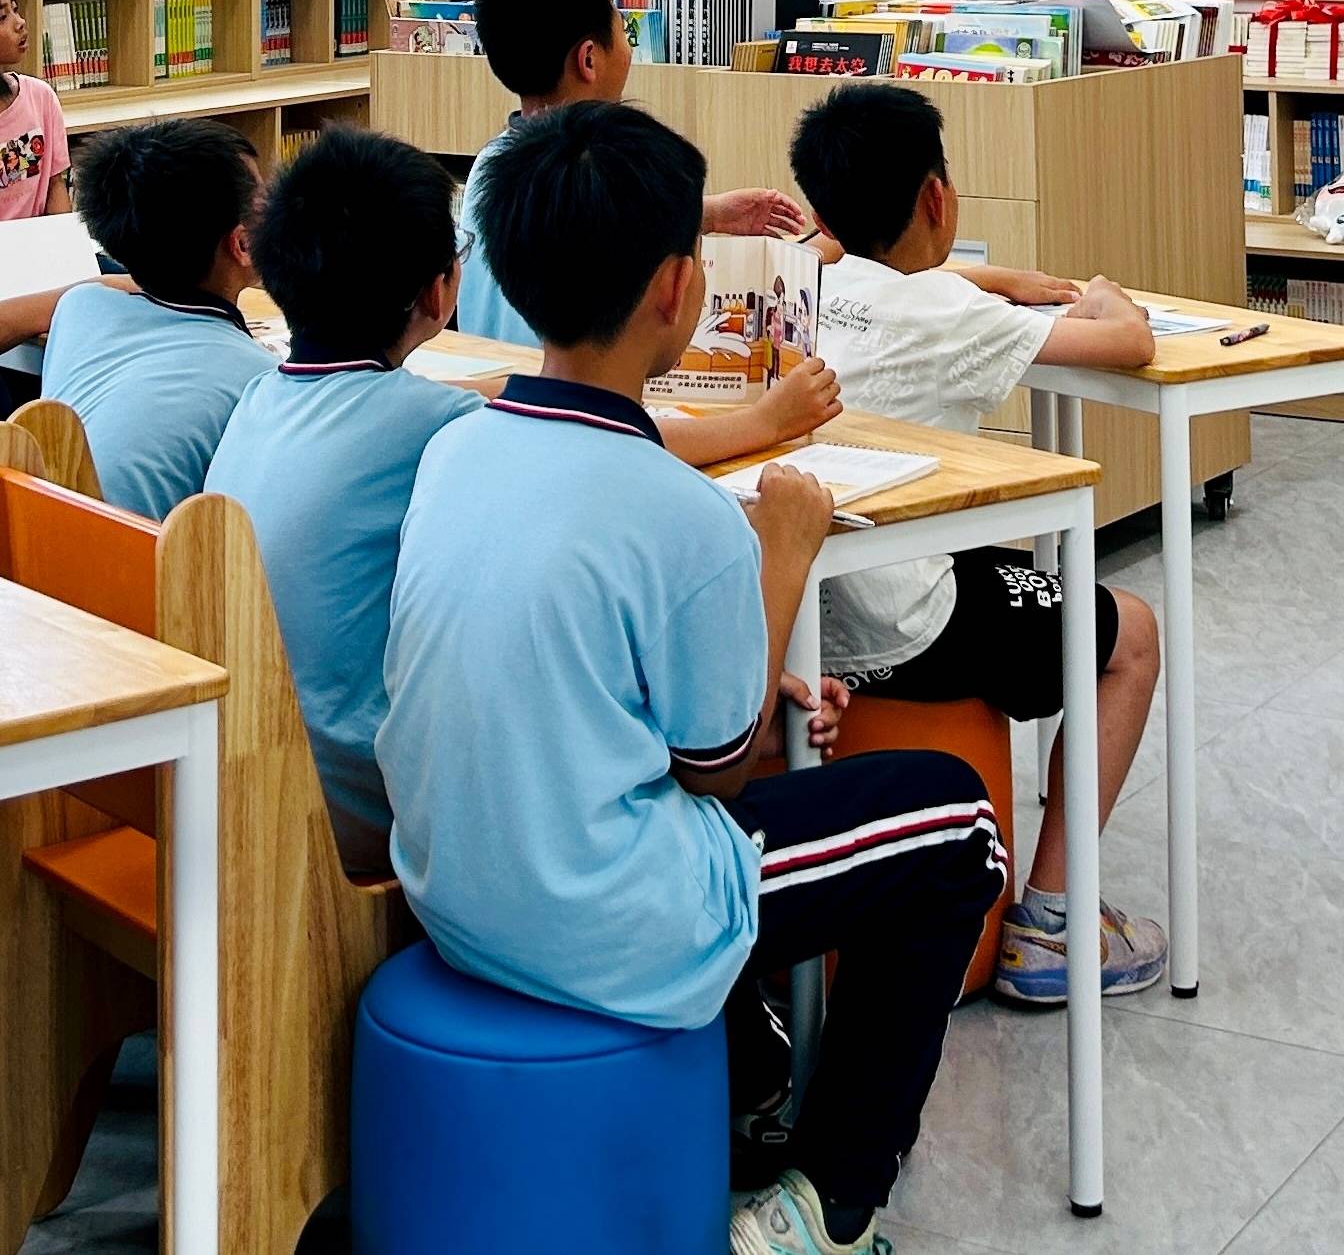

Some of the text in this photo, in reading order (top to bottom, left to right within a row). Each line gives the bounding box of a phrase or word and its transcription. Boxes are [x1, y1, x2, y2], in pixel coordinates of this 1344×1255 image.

[788, 55, 866, 74] 我想去太空
